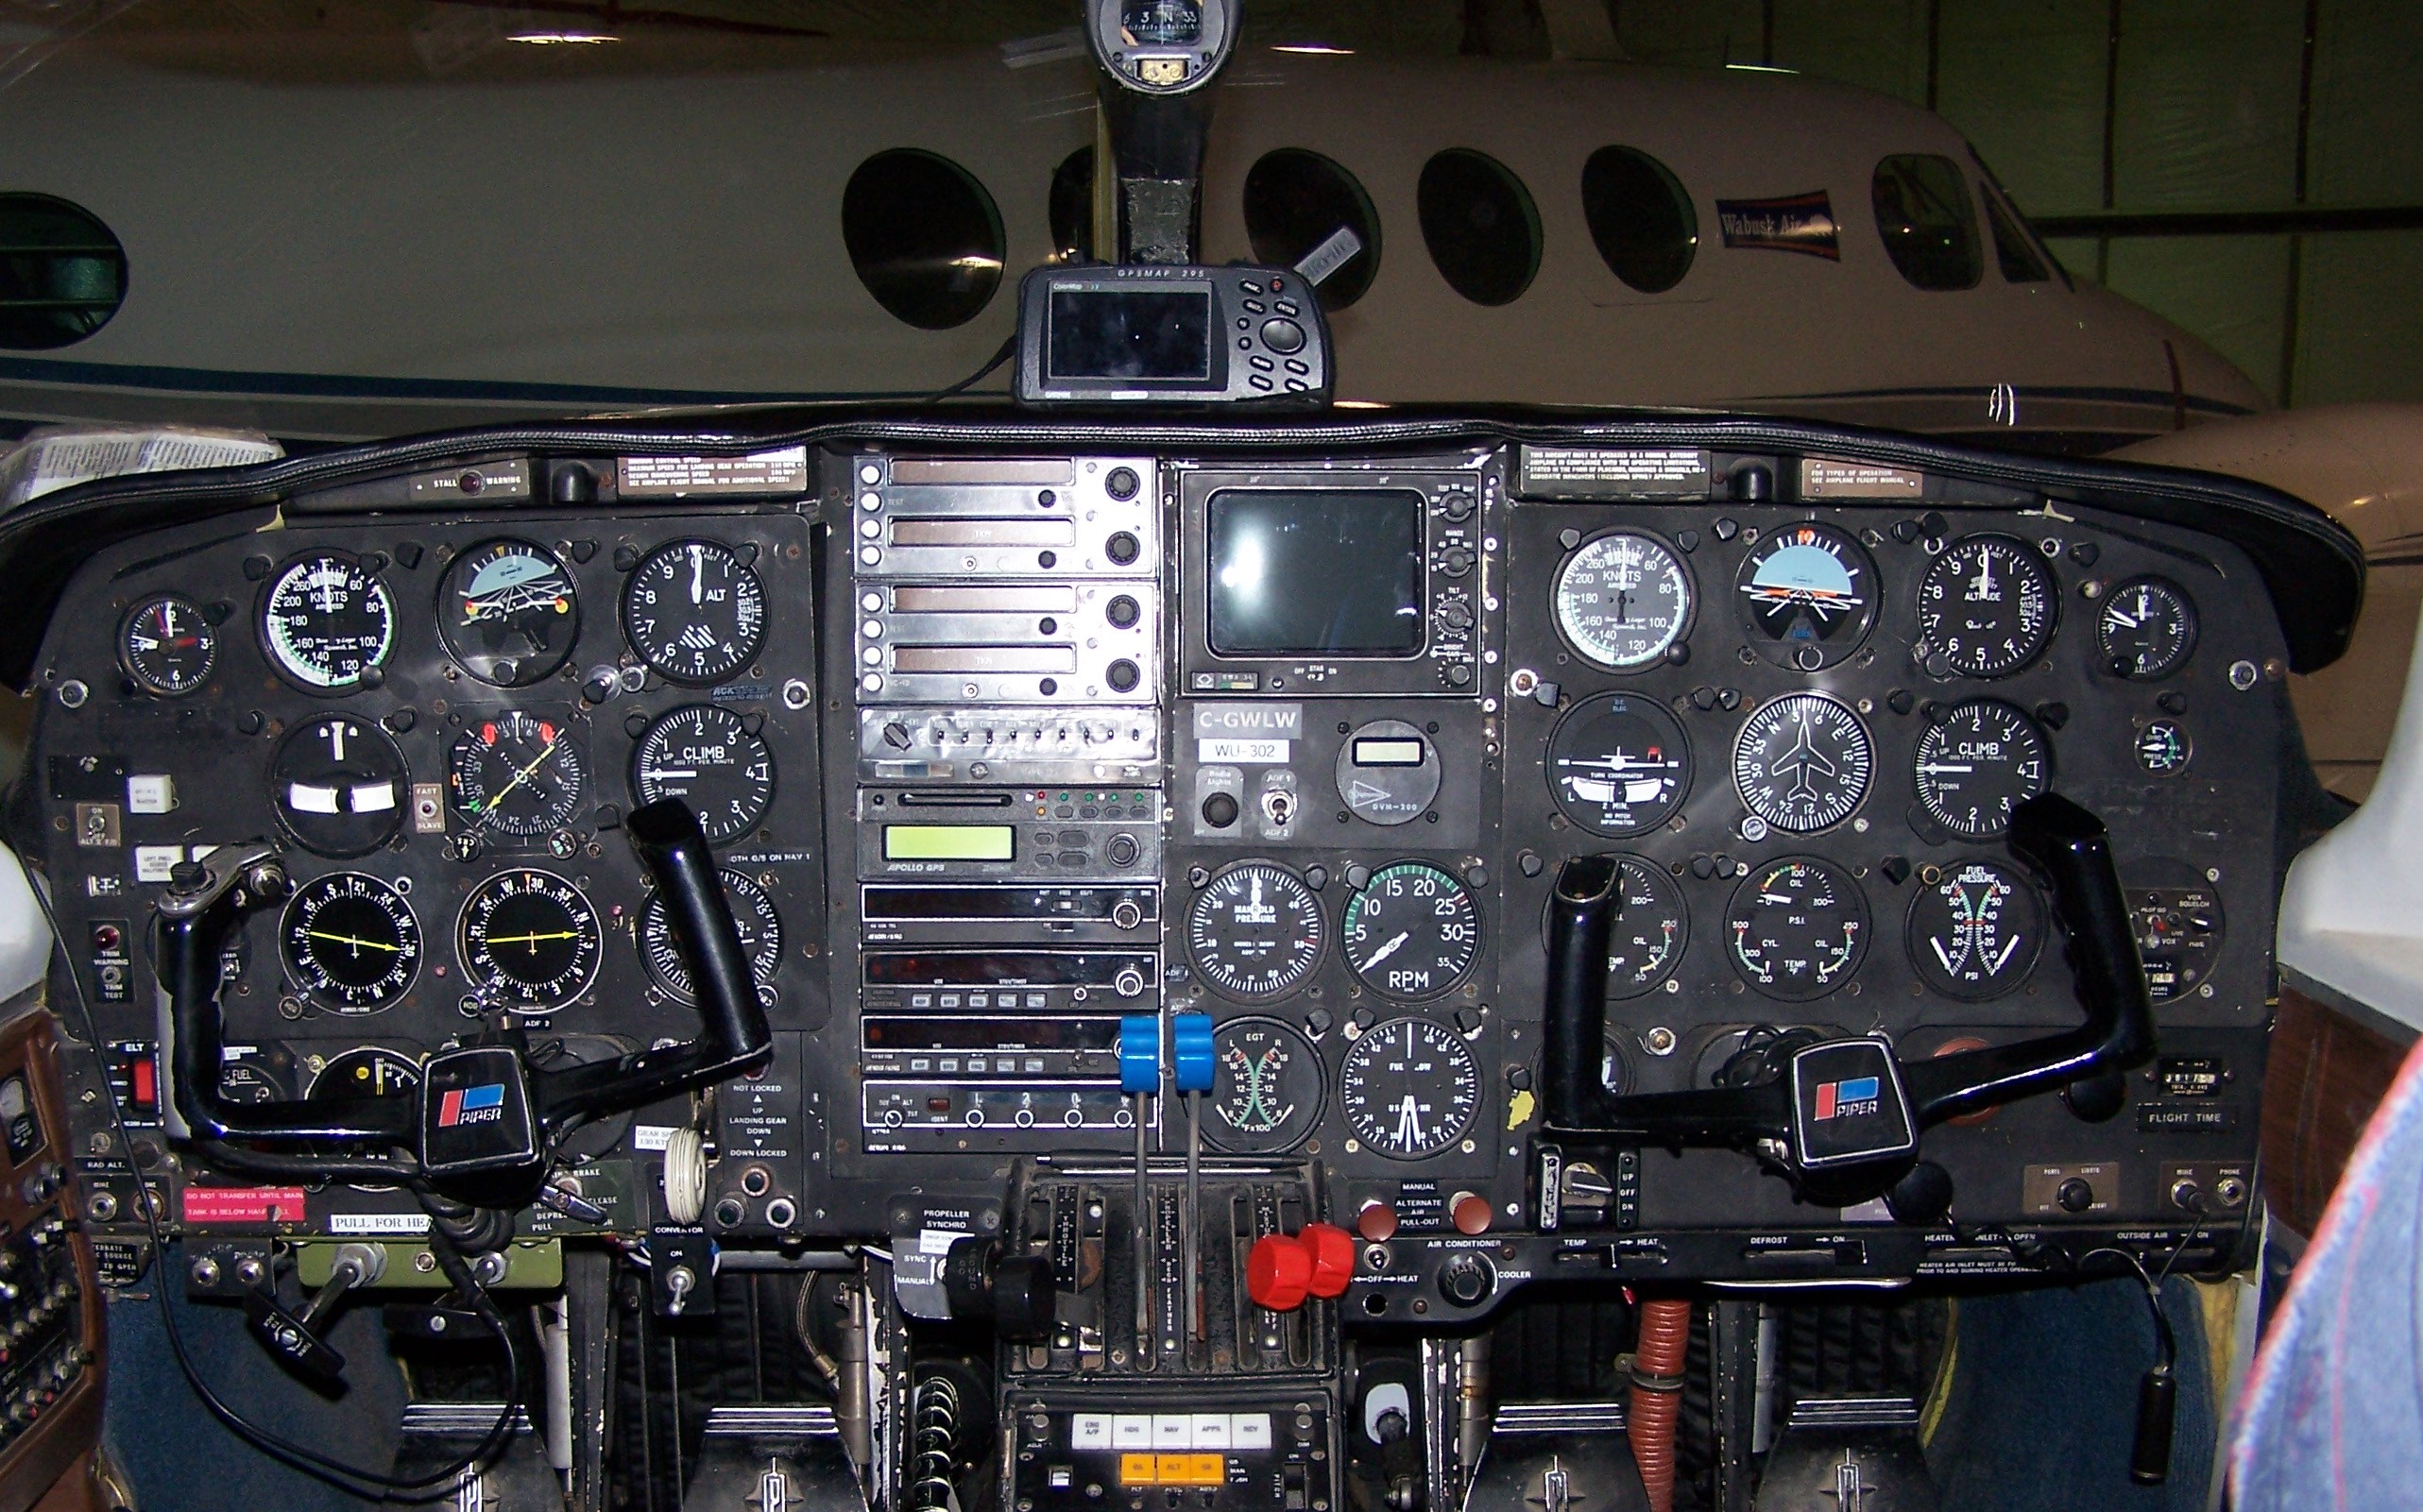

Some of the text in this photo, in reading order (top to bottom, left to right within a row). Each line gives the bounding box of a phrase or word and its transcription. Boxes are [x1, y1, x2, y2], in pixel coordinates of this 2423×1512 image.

[1118, 269, 1205, 278] GPSMAP 295
[434, 475, 521, 487] STALL WARNING
[1587, 559, 1605, 570] 260
[1644, 560, 1657, 571] 60
[1576, 573, 1594, 585] 200
[1603, 570, 1641, 582] KNTS
[293, 580, 312, 591] 260
[350, 579, 363, 591] 60
[1659, 584, 1672, 594] 80
[707, 588, 727, 603] ALT
[1580, 593, 1598, 603] 180
[1965, 592, 2001, 601] ALTUDE
[283, 596, 301, 607] 200
[367, 602, 379, 613] 80
[291, 615, 308, 627] 180
[1585, 616, 1602, 627] 160
[1649, 617, 1666, 628] 100
[1598, 630, 1616, 641] 140
[296, 637, 314, 650] 160
[359, 636, 377, 648] 100
[1628, 639, 1646, 651] 120
[311, 651, 330, 662] 140
[341, 659, 359, 671] 120
[1199, 711, 1296, 729] C-GWLW
[683, 746, 725, 759] CLIMB
[1215, 744, 1275, 757] WU-302
[1958, 742, 2000, 756] CLIMB
[888, 863, 923, 872] APOLLO
[1966, 866, 1986, 875] FUEL
[531, 877, 543, 889] 30
[1790, 879, 1803, 888] OIL
[1957, 874, 1997, 883] PRESSURE
[1387, 879, 1403, 896] 15
[1413, 879, 1435, 896] 20
[1940, 885, 1952, 895] 60
[1999, 885, 2010, 895] 60
[1288, 901, 1300, 909] 40
[1631, 896, 1647, 905] 200
[1813, 897, 1828, 906] 200
[1364, 899, 1381, 916] 10
[1435, 899, 1456, 916] 25
[1952, 910, 1964, 920] 40
[1732, 920, 1749, 929] 500
[1954, 925, 1965, 934] 30
[1356, 925, 1366, 942] 5
[1441, 925, 1463, 942] 30
[1633, 936, 1647, 945] OIL
[1438, 957, 1450, 967] 35
[1389, 971, 1429, 988] RPM
[1759, 975, 1773, 983] 100
[1965, 971, 1978, 980] PSI
[1246, 1033, 1264, 1042] EGT
[126, 1044, 144, 1052] ELT
[231, 1068, 253, 1080] FUEL
[1233, 1097, 1243, 1106] 10
[1836, 1100, 1878, 1118] PIPER
[460, 1108, 502, 1125] PIPER
[2149, 1113, 2222, 1123] FLIGHT TIME
[1622, 1172, 1634, 1181] UP
[1402, 1182, 1436, 1191] MANUAL
[1619, 1188, 1635, 1198] OFF
[1396, 1198, 1442, 1207] ALTERNATE
[335, 1217, 431, 1229] PULL FOR HEA
[1400, 1217, 1440, 1226] PULL-OUT
[1750, 1235, 1787, 1245] DEFROST
[1833, 1235, 1845, 1244] ON
[2117, 1232, 2168, 1240] OUTSIDE AIR
[2197, 1231, 2209, 1239] ON
[1445, 1239, 1501, 1248] CONDITIONER
[1563, 1238, 1587, 1247] TEMP
[1637, 1237, 1659, 1247] HEAT
[1498, 1270, 1531, 1279] COOLER
[897, 1277, 929, 1285] MANUAL
